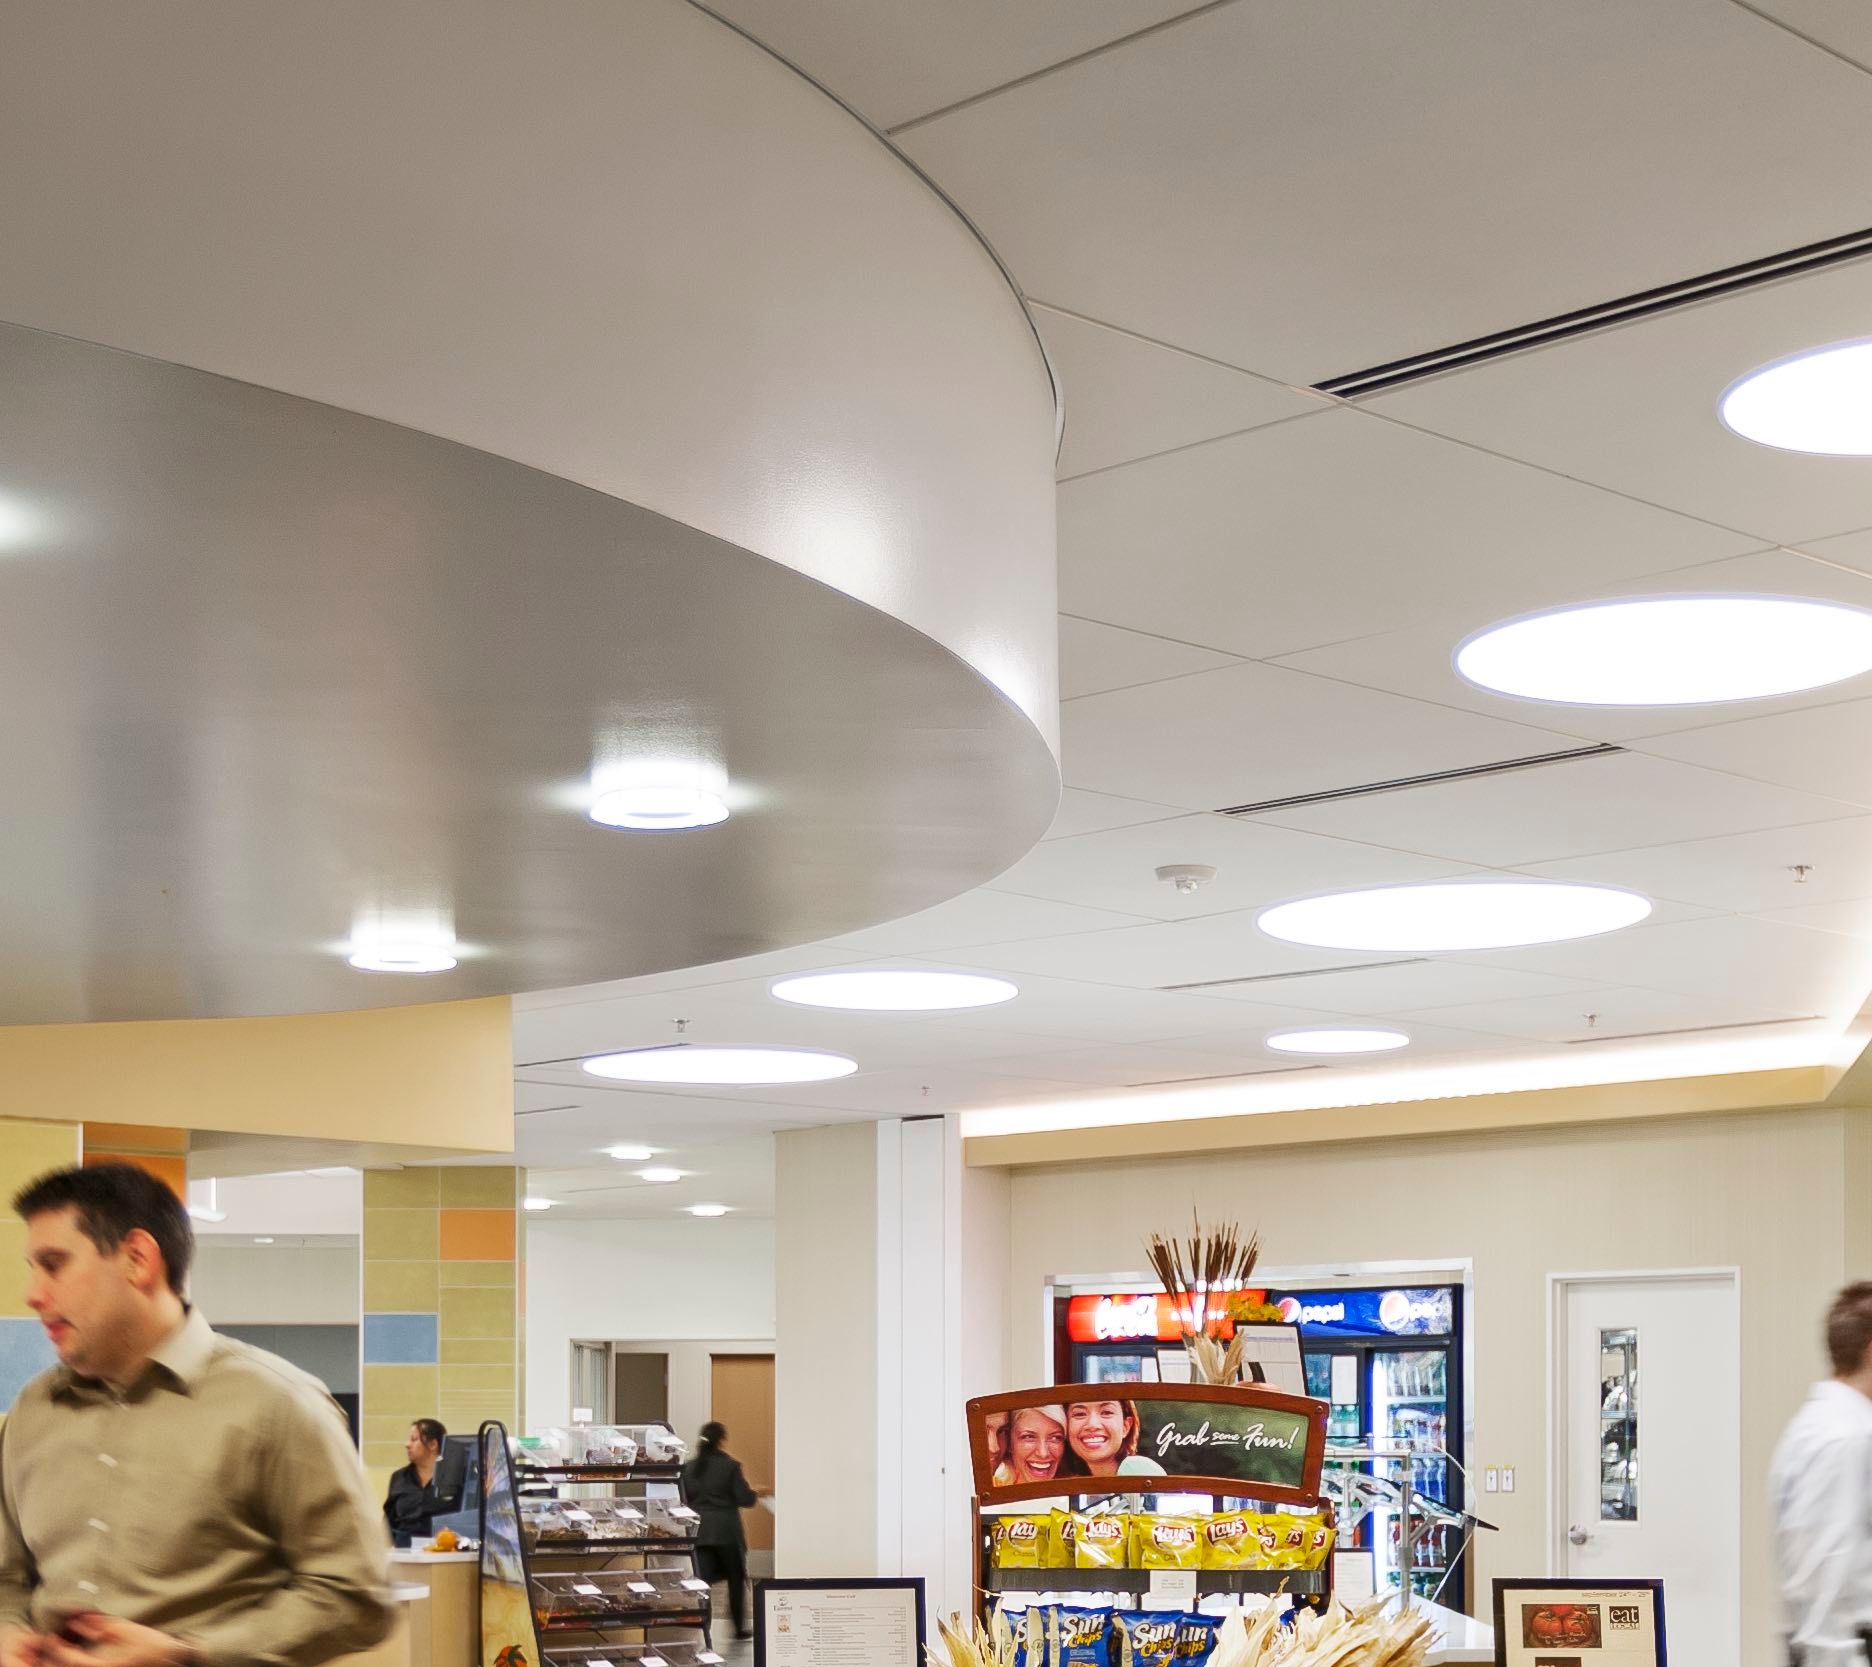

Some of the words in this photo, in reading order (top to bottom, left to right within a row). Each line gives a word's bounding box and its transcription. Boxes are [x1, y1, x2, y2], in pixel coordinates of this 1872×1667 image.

[1302, 1302, 1345, 1324] pepsi
[1156, 1421, 1210, 1457] Grab
[1211, 1431, 1241, 1443] some
[1243, 1423, 1300, 1450] Fun!
[1062, 1613, 1105, 1640] Sun
[1610, 1608, 1638, 1624] eat
[1067, 1630, 1103, 1648] Chips
[1133, 1622, 1176, 1650] Sun
[1180, 1625, 1208, 1643] un
